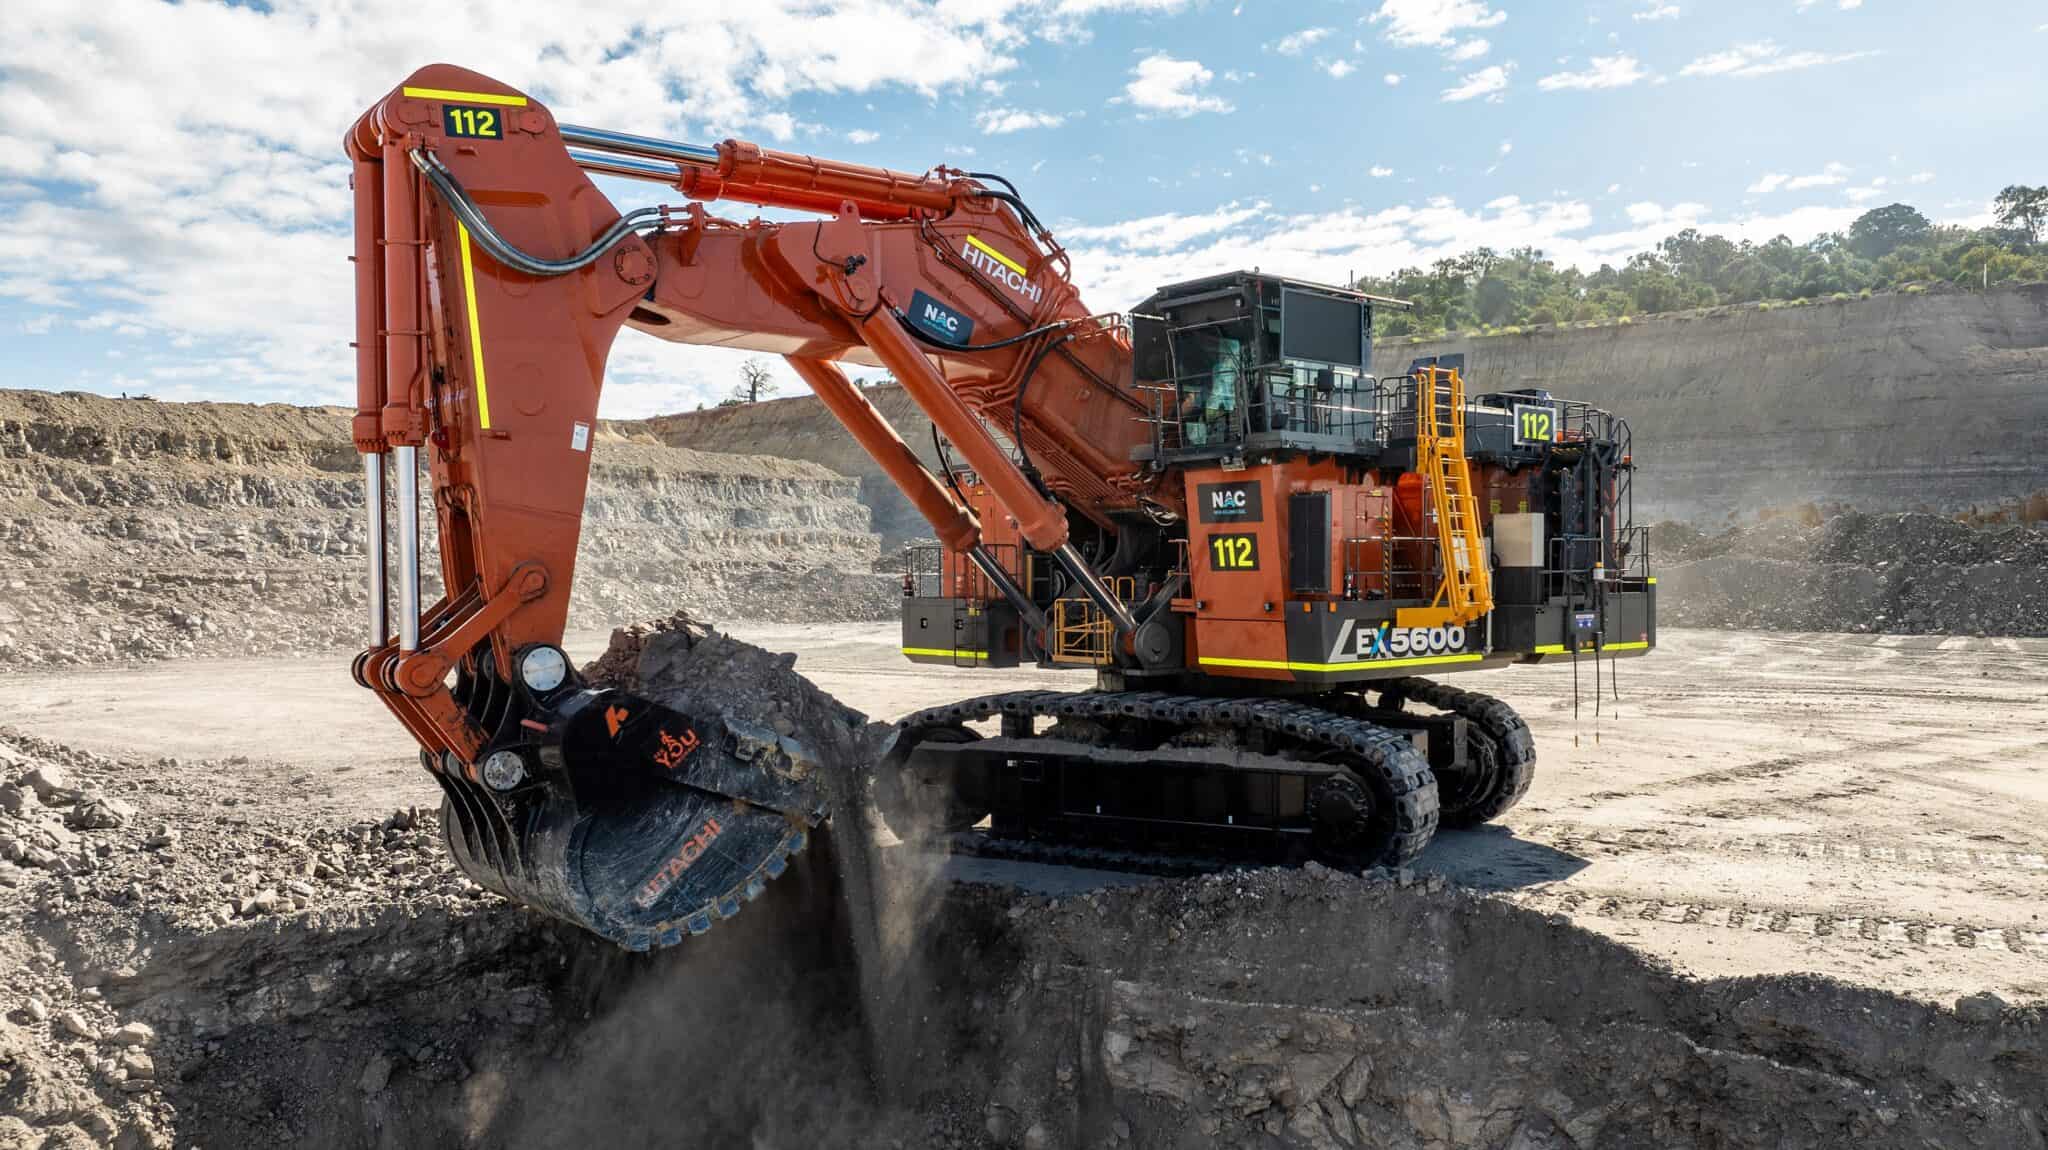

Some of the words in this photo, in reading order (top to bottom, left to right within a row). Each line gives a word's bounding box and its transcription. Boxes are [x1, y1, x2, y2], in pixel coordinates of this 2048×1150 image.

[450, 109, 497, 137] 112
[961, 242, 1043, 304] HITACHI
[923, 303, 959, 332] NAC
[1520, 411, 1551, 441] 112
[1211, 490, 1246, 508] NAC
[1213, 537, 1254, 568] 112
